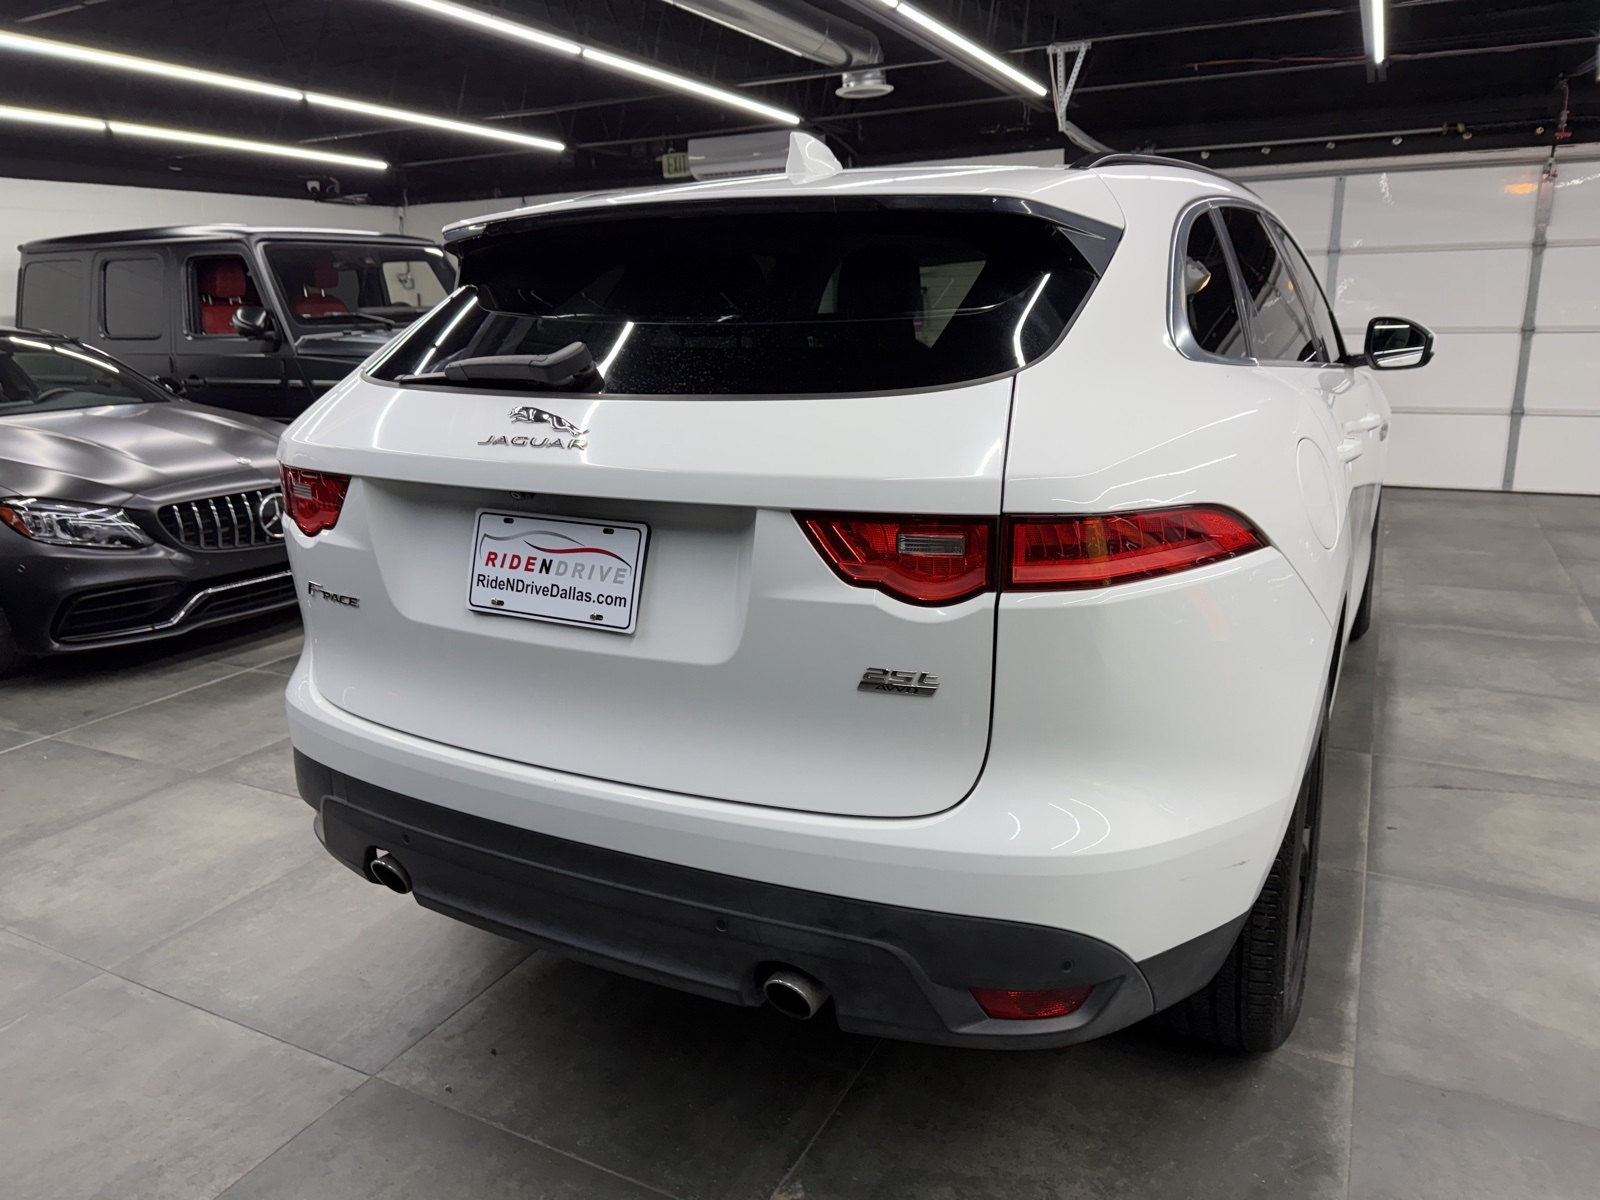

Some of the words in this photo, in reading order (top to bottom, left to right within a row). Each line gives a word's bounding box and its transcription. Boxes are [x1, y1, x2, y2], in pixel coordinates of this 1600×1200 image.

[666, 154, 688, 175] EXIT
[478, 435, 588, 450] JAGUAR
[485, 551, 627, 585] RIDENDRIVE
[476, 574, 627, 608] RideNDriveDallas.com
[874, 684, 919, 694] AWD
